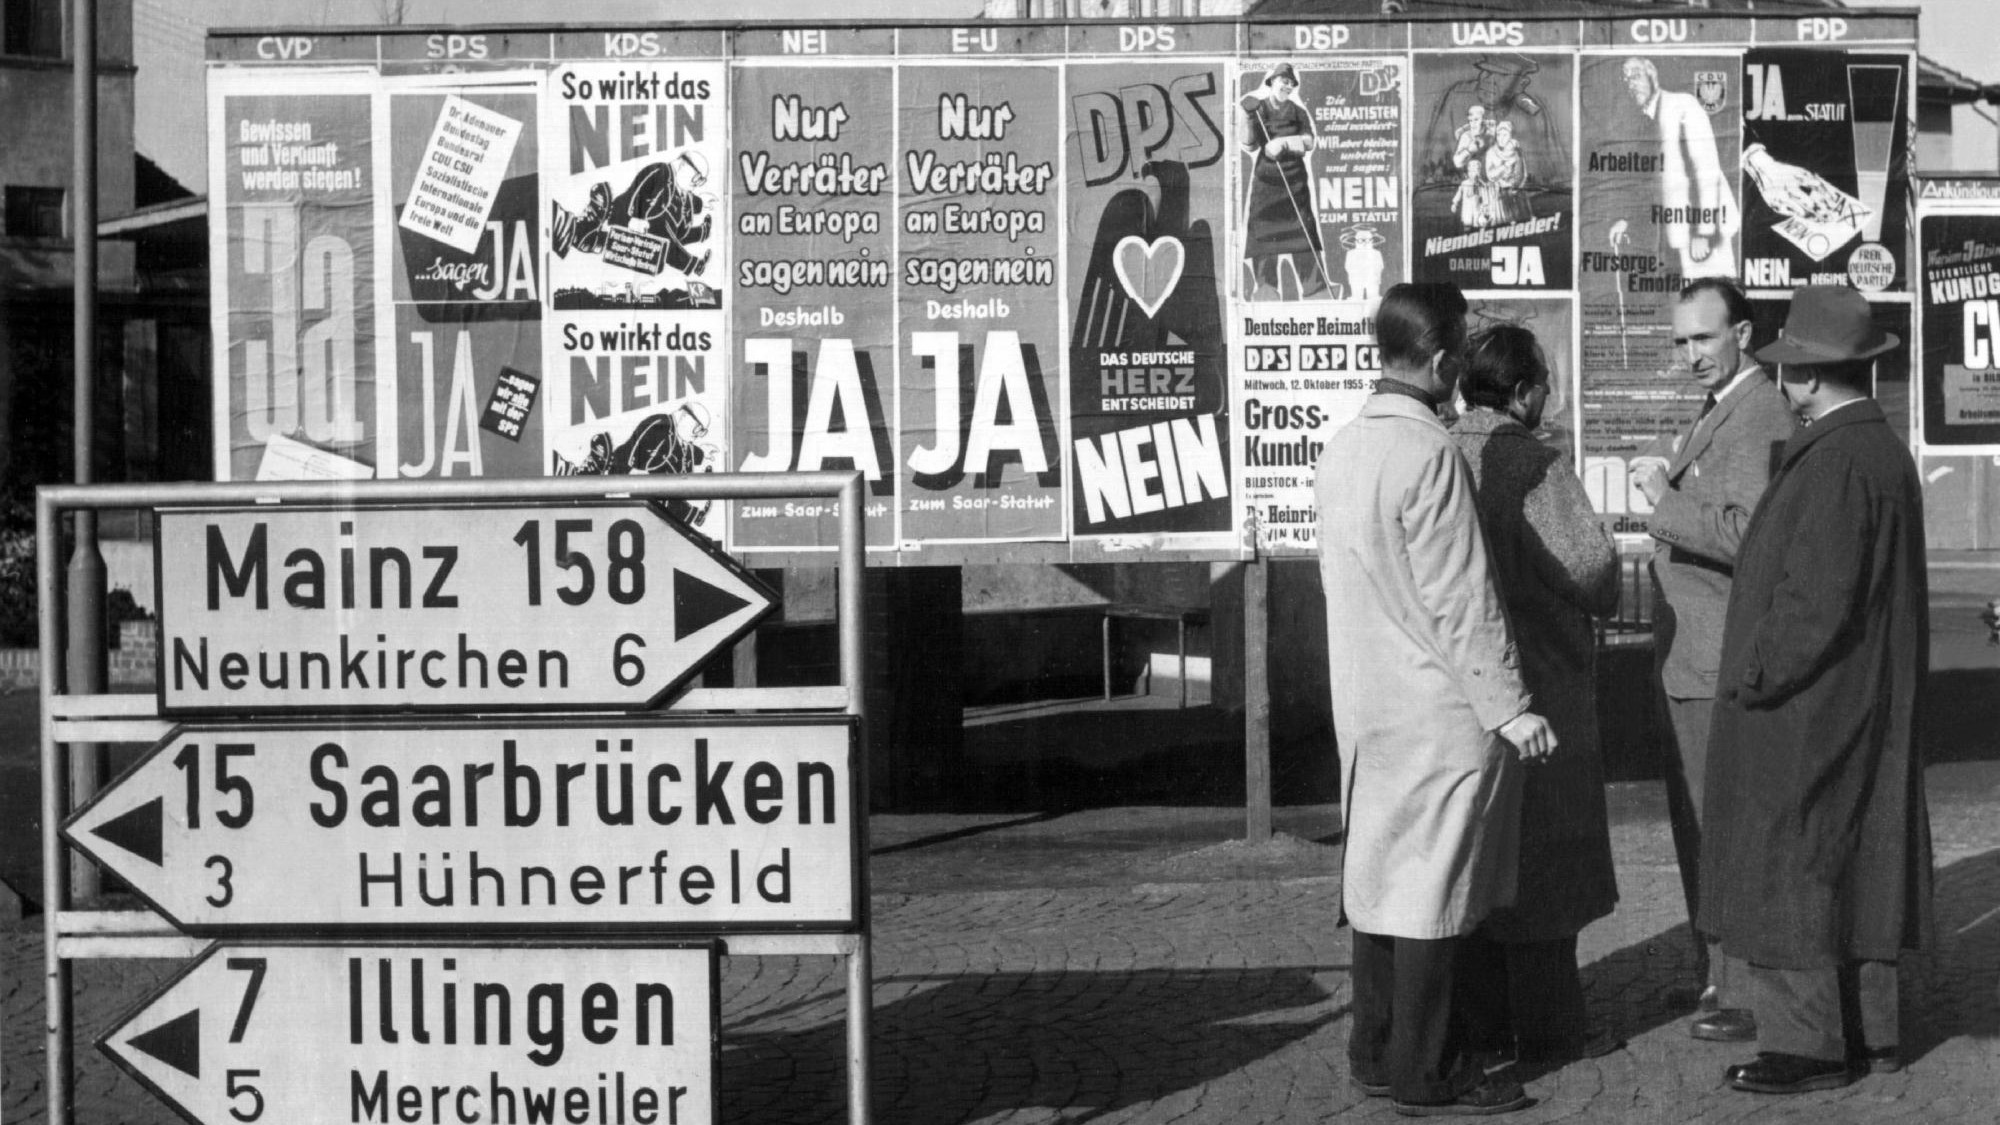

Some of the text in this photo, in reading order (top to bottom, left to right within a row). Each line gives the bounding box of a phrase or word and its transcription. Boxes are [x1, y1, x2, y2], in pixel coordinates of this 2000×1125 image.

[783, 29, 827, 53] NEI
[952, 27, 998, 53] E-U
[1119, 26, 1175, 51] DPS
[1295, 25, 1349, 49] DSP
[1452, 22, 1524, 46] UAPS
[1631, 19, 1687, 42] CDU
[1797, 17, 1848, 40] FDP
[257, 37, 312, 59] CVP
[427, 34, 488, 58] SPS
[562, 71, 711, 99] So wirkt das
[1746, 64, 1846, 121] JA STATUT
[1315, 106, 1398, 120] SEPARATISTEN
[1325, 95, 1346, 106] Die
[241, 119, 311, 141] Gewissen
[772, 94, 848, 140] Nur
[939, 93, 1015, 140] Nur
[1072, 72, 1225, 187] DPS
[241, 142, 337, 167] und Vernunft
[570, 105, 706, 176] NEIN
[1317, 135, 1339, 149] WIR
[242, 166, 299, 190] werden
[453, 159, 474, 175] CSU
[740, 151, 888, 195] Verräter
[907, 150, 1053, 194] Verräter
[426, 165, 489, 199] Sozialistische
[1320, 176, 1398, 209] NEIN
[420, 181, 484, 214] Internationale
[409, 210, 454, 236] freie Welt
[415, 195, 480, 230] Europa und die
[740, 206, 879, 243] an Europa
[906, 203, 1045, 243] an Europa
[1320, 212, 1398, 223] ZUM STATUT
[1424, 212, 1562, 257] Niemals wieder!
[472, 220, 538, 300] JA
[740, 248, 888, 293] sagen nein
[906, 246, 1053, 293] sagen nein
[1450, 246, 1546, 285] DARUM JA
[1583, 251, 1664, 274] Fürsorge-
[1745, 258, 1848, 286] NEIN REGIME
[1857, 275, 1889, 287] PARTEI
[760, 307, 844, 327] Deshalb
[926, 300, 1010, 320] Deshalb
[563, 323, 712, 351] So wirkt das
[1245, 317, 1314, 336] Deutscher
[1100, 351, 1195, 365] DAS DEUTSCHE
[1247, 347, 1289, 370] DPS
[1301, 347, 1345, 370] DSP
[571, 356, 707, 426] NEIN
[1102, 367, 1195, 395] HERZ
[1245, 379, 1288, 390] Mittwoch,
[1291, 380, 1302, 390] 12.
[1304, 379, 1340, 390] Oktober
[399, 331, 483, 477] JA
[739, 338, 882, 480] JA
[907, 330, 1048, 474] JA
[1102, 395, 1195, 411] ENTSCHEIDET
[1245, 398, 1329, 431] Gross-
[498, 419, 519, 436] SPS
[1245, 435, 1324, 470] Kundg
[1074, 413, 1228, 524] NEIN
[1245, 477, 1297, 488] BILDSTOCK
[741, 502, 887, 518] zum Saar-Sut
[910, 495, 1055, 511] zum Saar-Statut
[207, 519, 647, 610] Mainz 158
[173, 634, 645, 690] Neunkirchen 6
[174, 738, 836, 829] 15 Saarbrücken
[205, 848, 791, 907] 3 Hühnerfeld
[227, 958, 675, 1066] 7 Illingen
[227, 1069, 687, 1125] 5 Merchweiler
